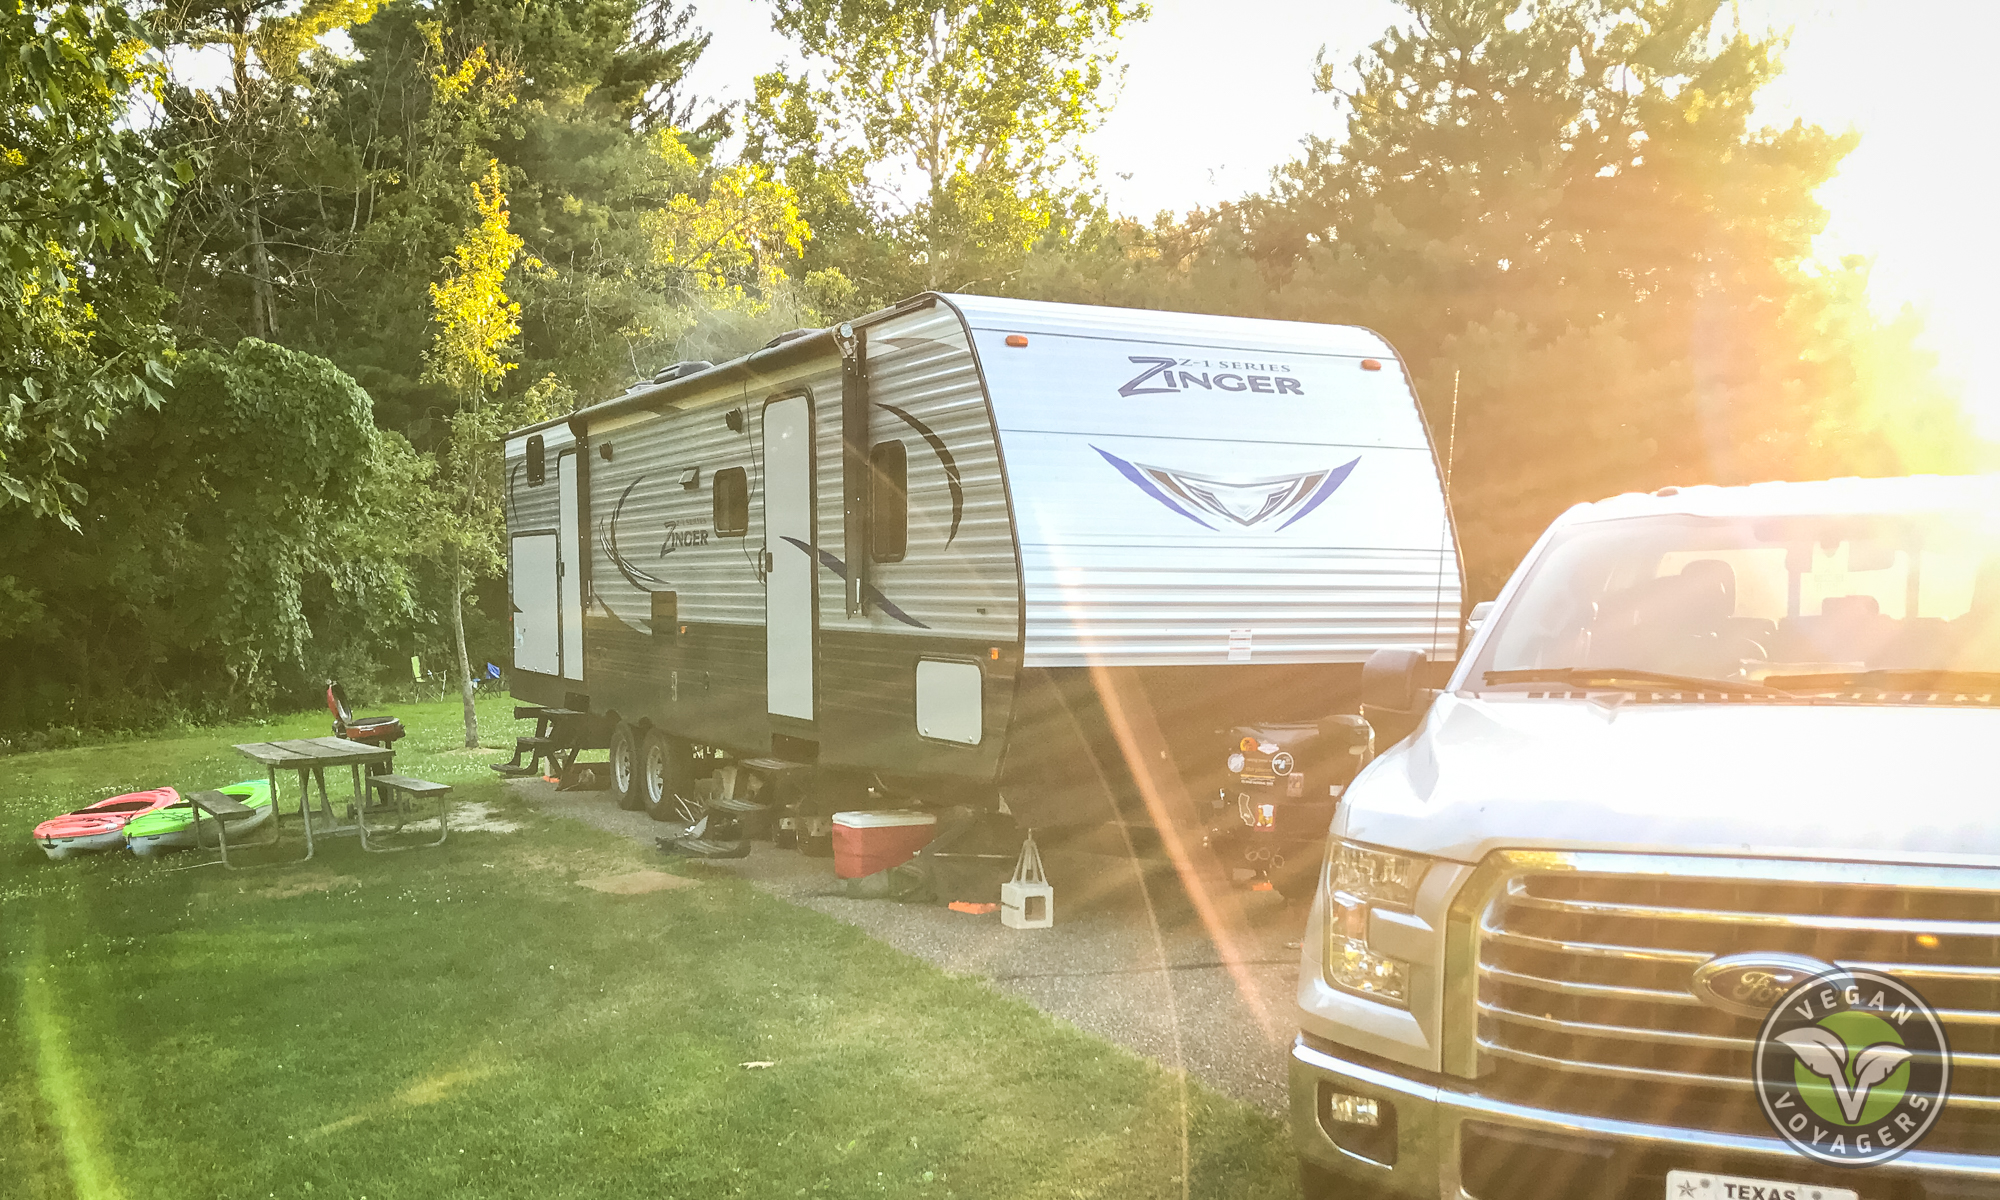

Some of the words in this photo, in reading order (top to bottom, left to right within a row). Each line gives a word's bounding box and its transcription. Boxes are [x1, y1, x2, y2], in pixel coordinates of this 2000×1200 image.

[1118, 356, 1305, 398] ZINGER
[1218, 361, 1291, 373] SERIES
[1733, 971, 1796, 1002] For
[1724, 1183, 1796, 1200] TEXAS
